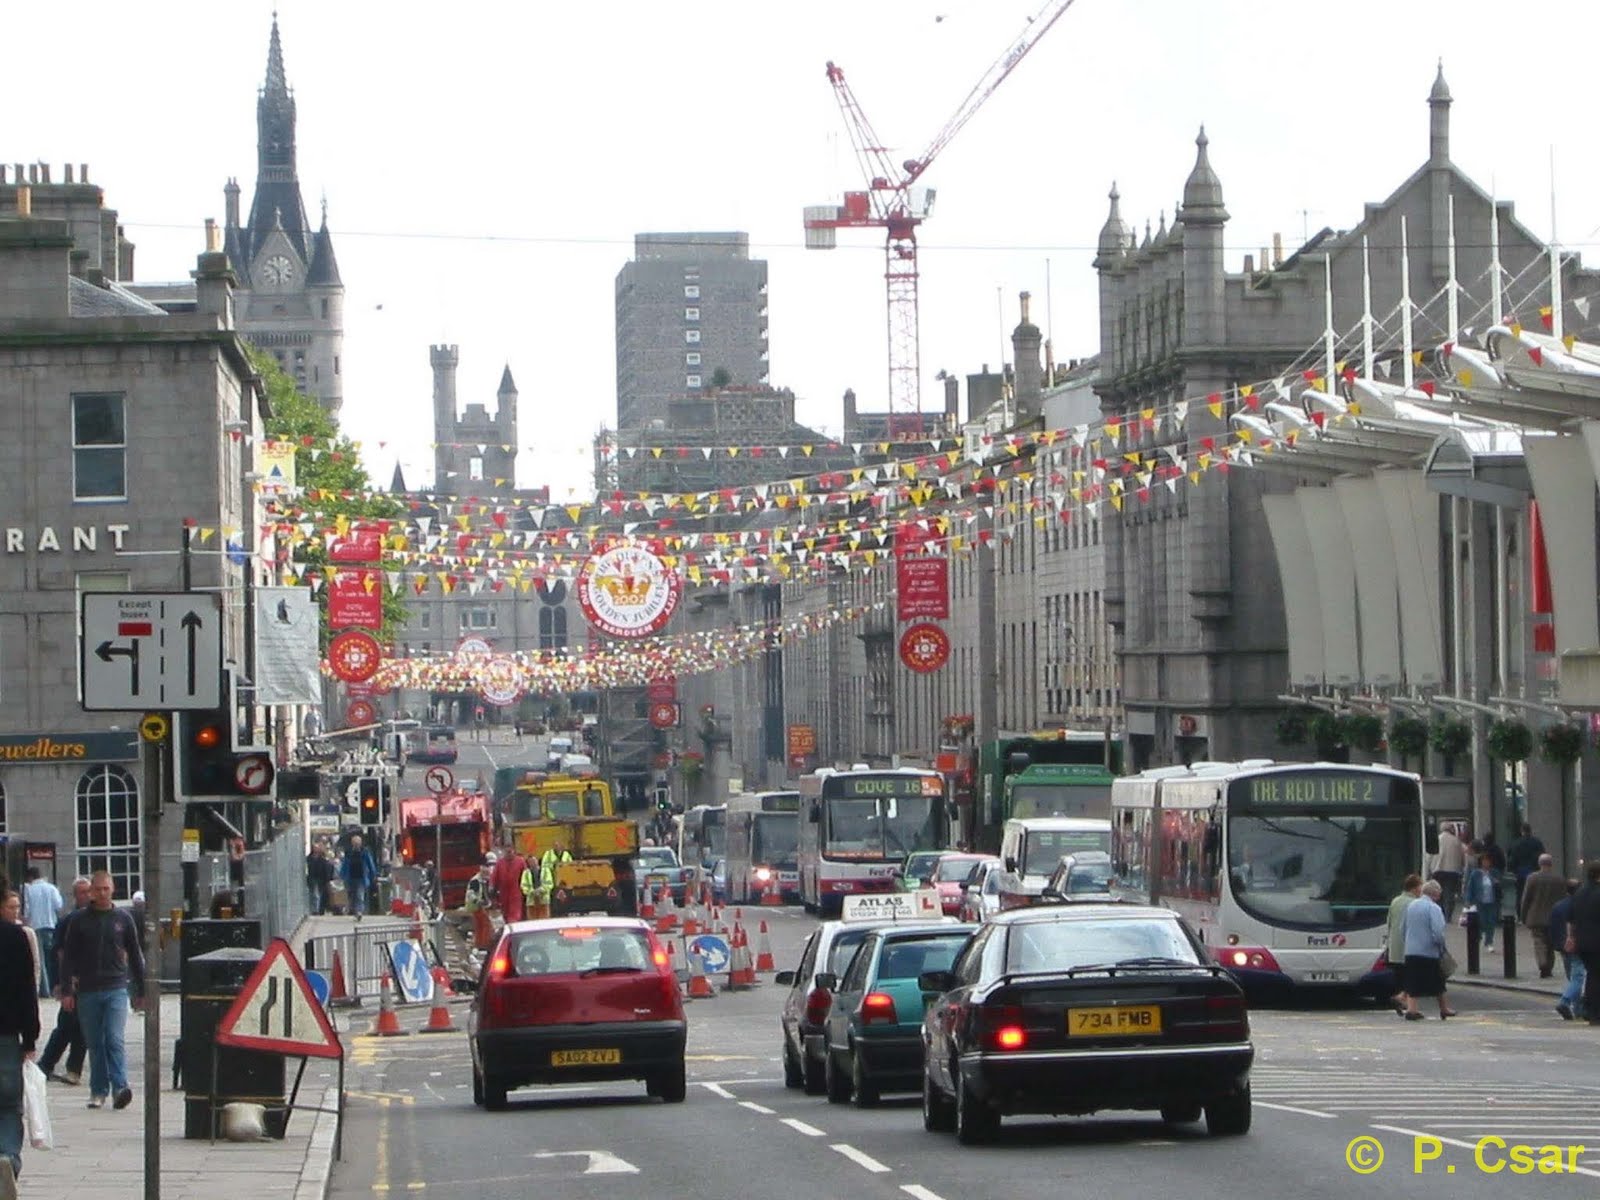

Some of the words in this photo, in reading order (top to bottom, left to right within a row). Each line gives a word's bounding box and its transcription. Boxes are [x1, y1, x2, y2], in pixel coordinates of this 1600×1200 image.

[6, 524, 129, 552] RANT
[118, 600, 152, 609] Except
[613, 595, 646, 606] 2002
[120, 610, 149, 618] buses
[594, 619, 654, 637] ABERDEEN
[854, 780, 896, 794] COVE
[904, 780, 920, 794] 16
[1253, 779, 1280, 801] THE
[1285, 779, 1315, 801] RED
[1321, 779, 1357, 801] LINE
[1363, 780, 1373, 800] 2
[858, 897, 904, 907] ATLAS
[922, 897, 934, 909] L
[1307, 936, 1329, 946] First
[1077, 1013, 1113, 1029] 734
[1117, 1011, 1153, 1027] FMB
